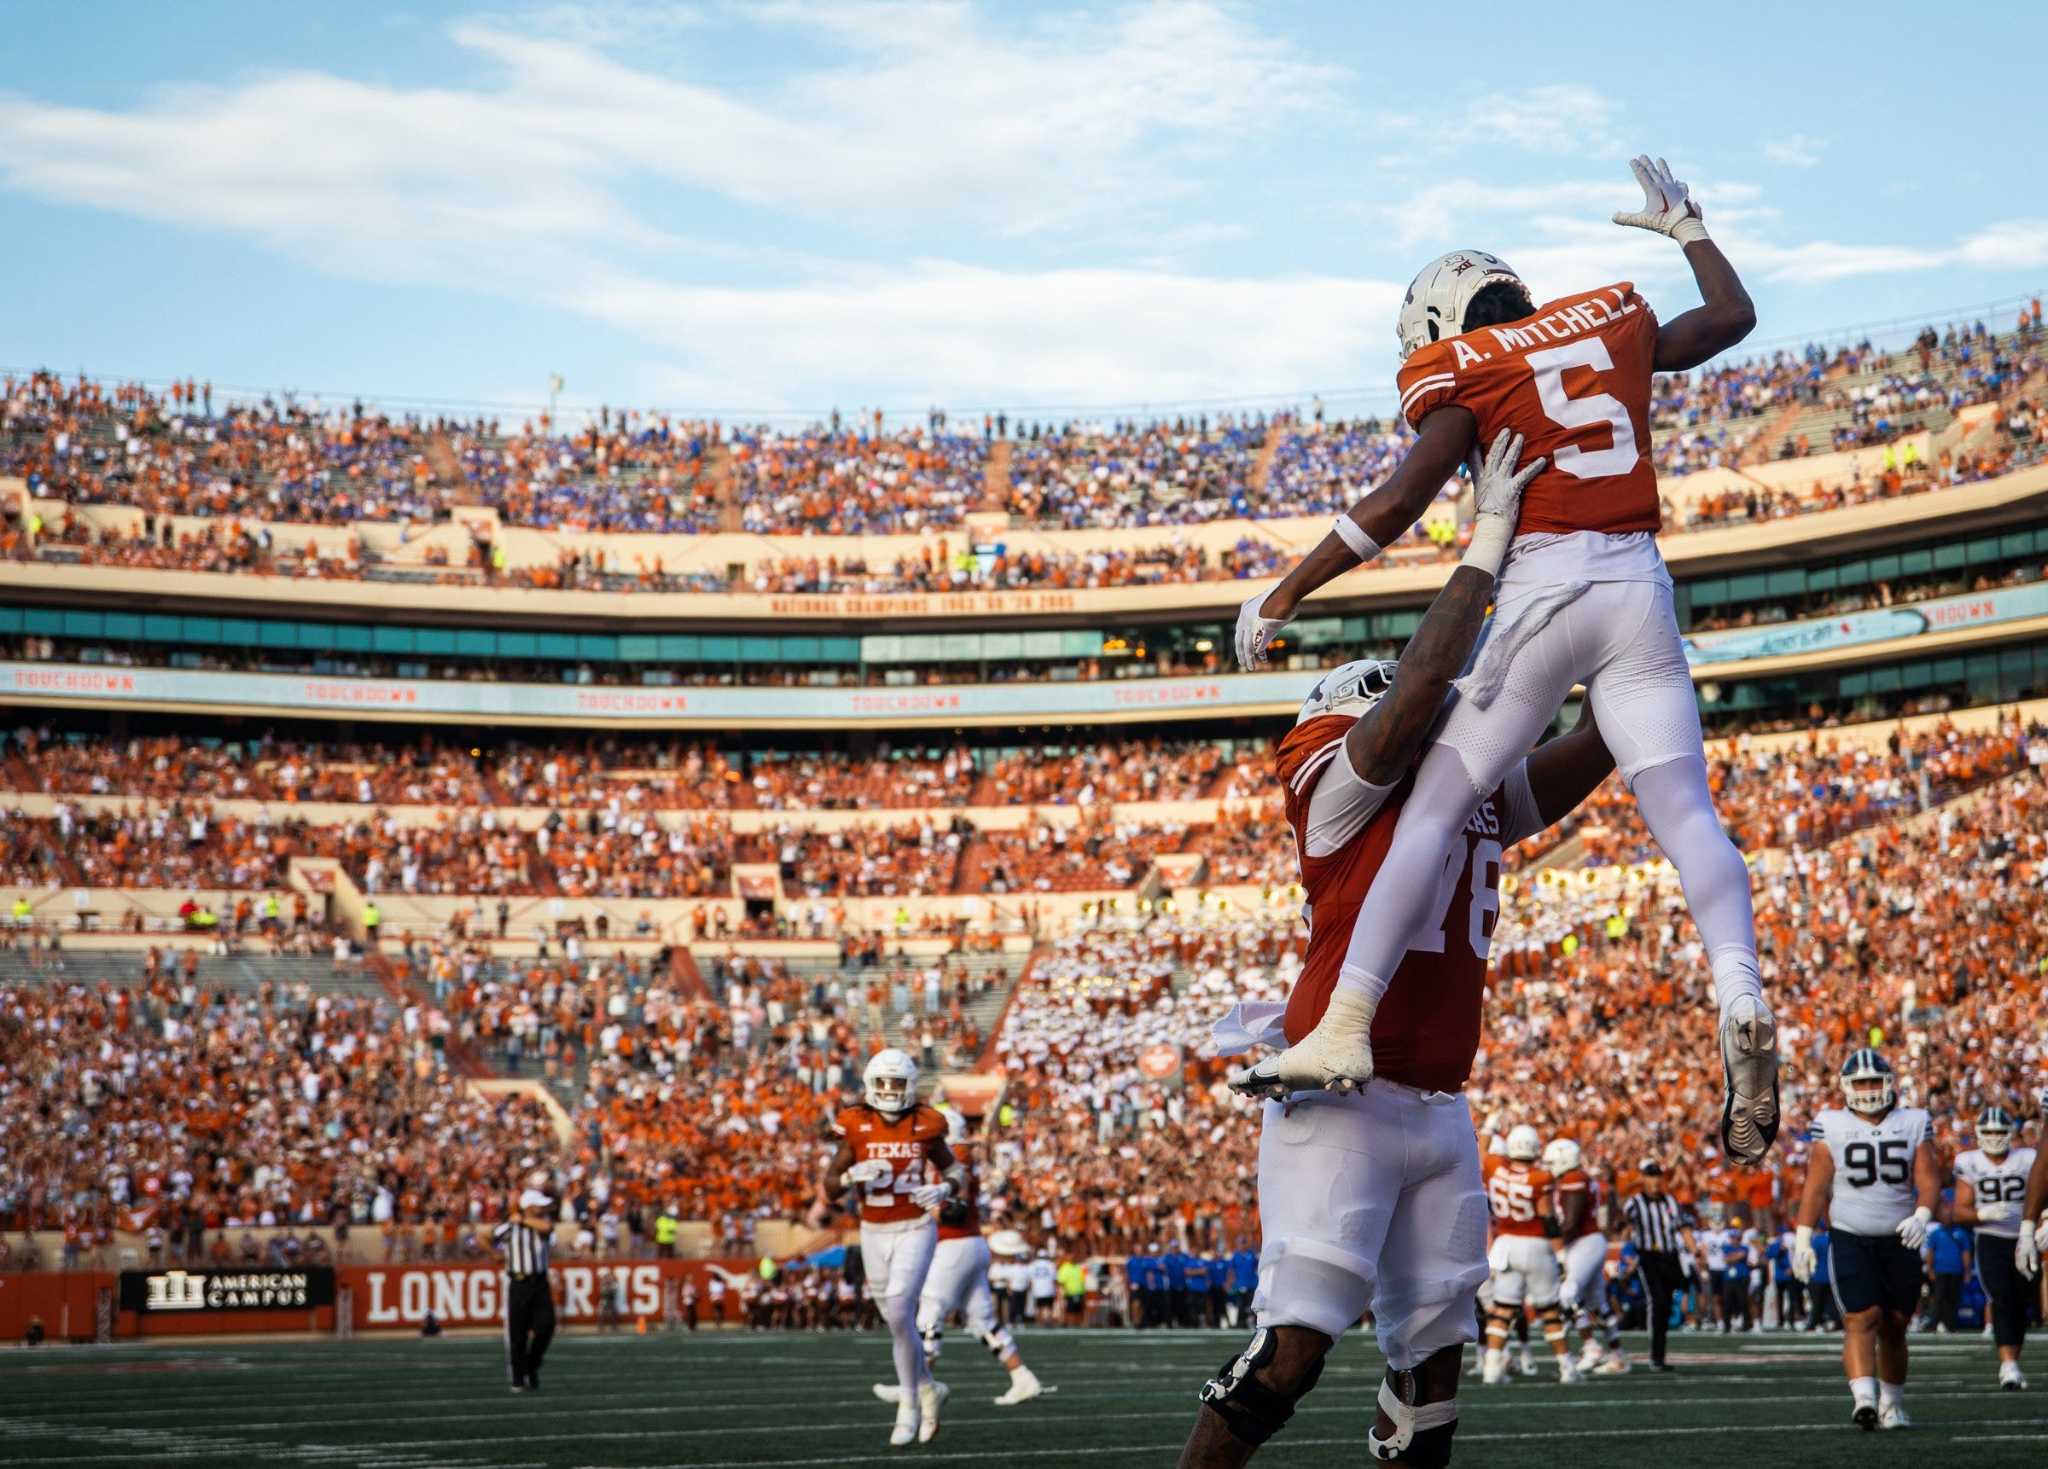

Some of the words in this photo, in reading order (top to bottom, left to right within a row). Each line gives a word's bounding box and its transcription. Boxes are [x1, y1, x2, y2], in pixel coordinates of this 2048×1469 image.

[1452, 339, 1492, 370] A.
[1489, 288, 1638, 352] MITCHELL
[1525, 336, 1639, 480] 5
[14, 671, 135, 690] TOUCHDOWN
[304, 684, 418, 703] TOUCHDOWN
[866, 1142, 922, 1158] TEXAS
[1845, 1140, 1909, 1187] 95
[863, 1159, 923, 1207] 24
[1978, 1176, 2025, 1203] 92
[209, 1274, 307, 1290] AMERICAN
[367, 1266, 661, 1322] LONGRNS
[207, 1289, 307, 1308] CAMPUS
